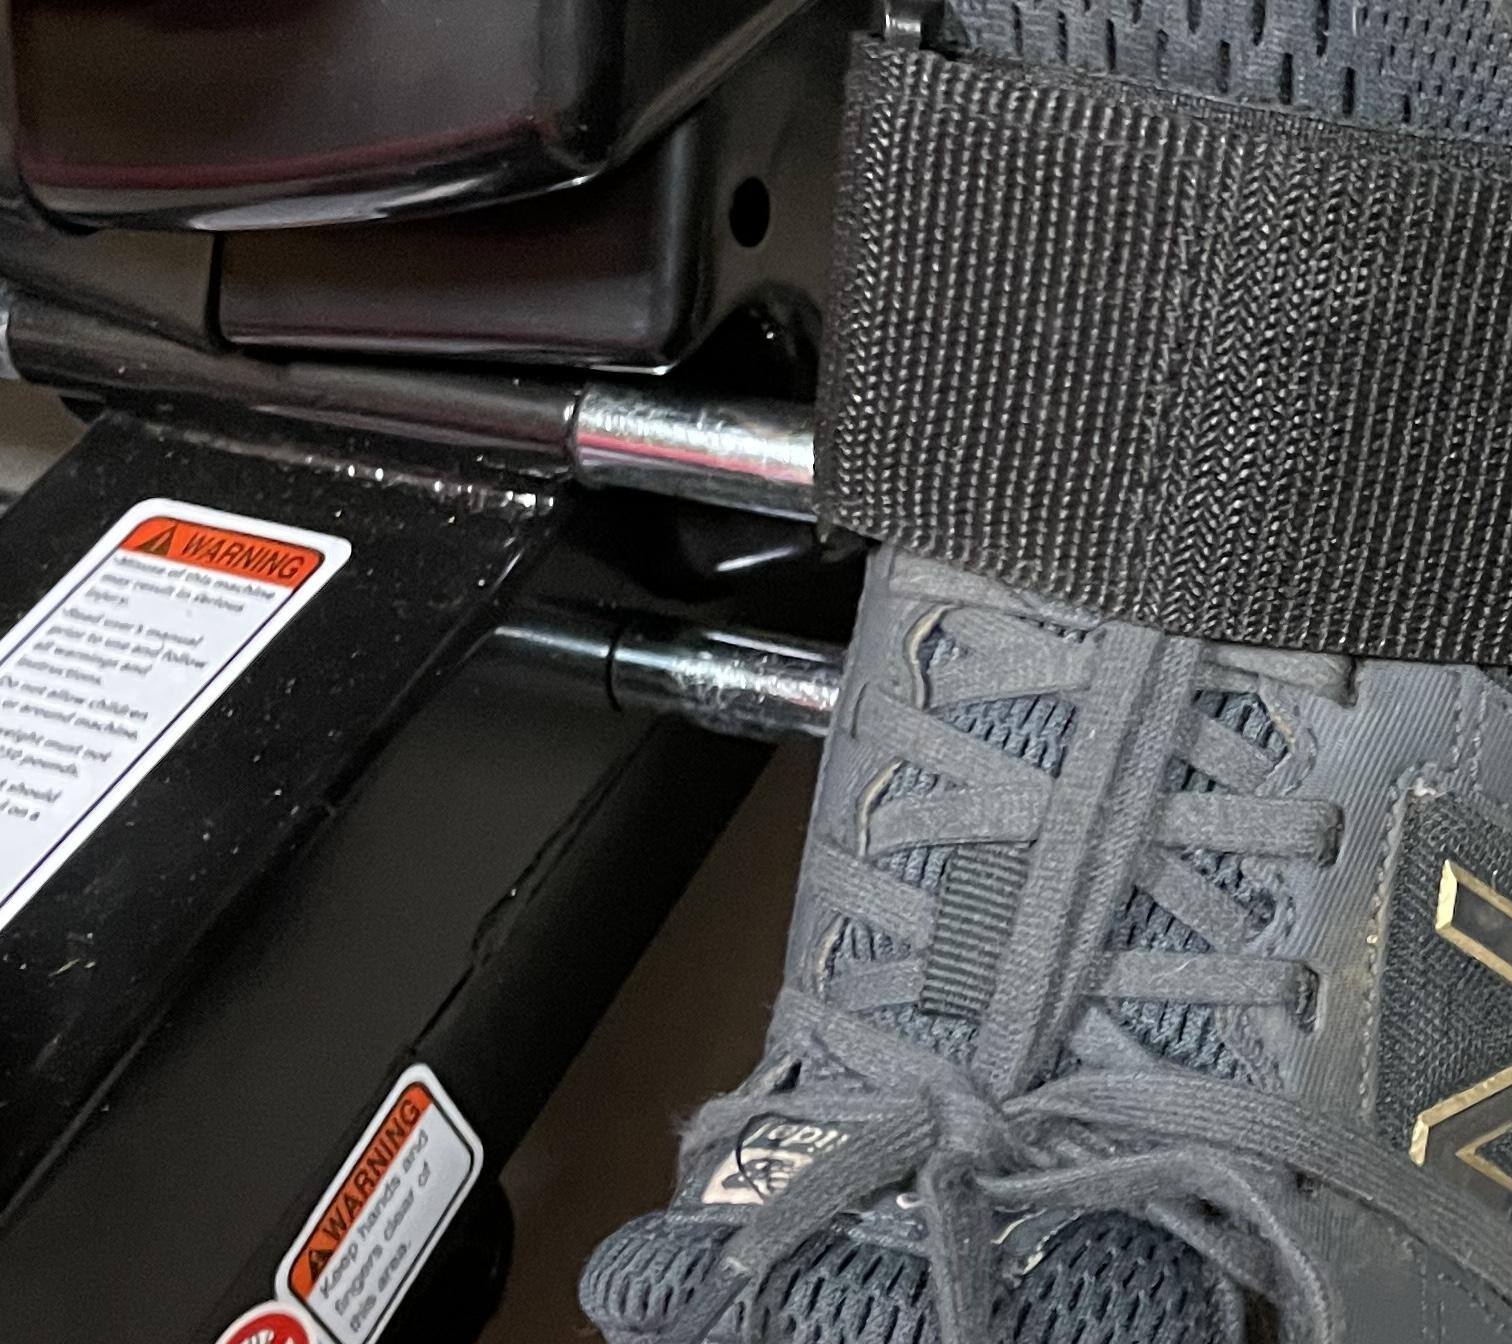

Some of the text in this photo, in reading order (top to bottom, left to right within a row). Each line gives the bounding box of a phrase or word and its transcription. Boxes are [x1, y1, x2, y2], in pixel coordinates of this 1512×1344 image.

[181, 529, 305, 580] WARNING
[319, 1128, 429, 1300] Keep hands and
[322, 1098, 421, 1242] WARNING
[334, 1159, 431, 1317] fingers clear of
[349, 1293, 377, 1334] this
